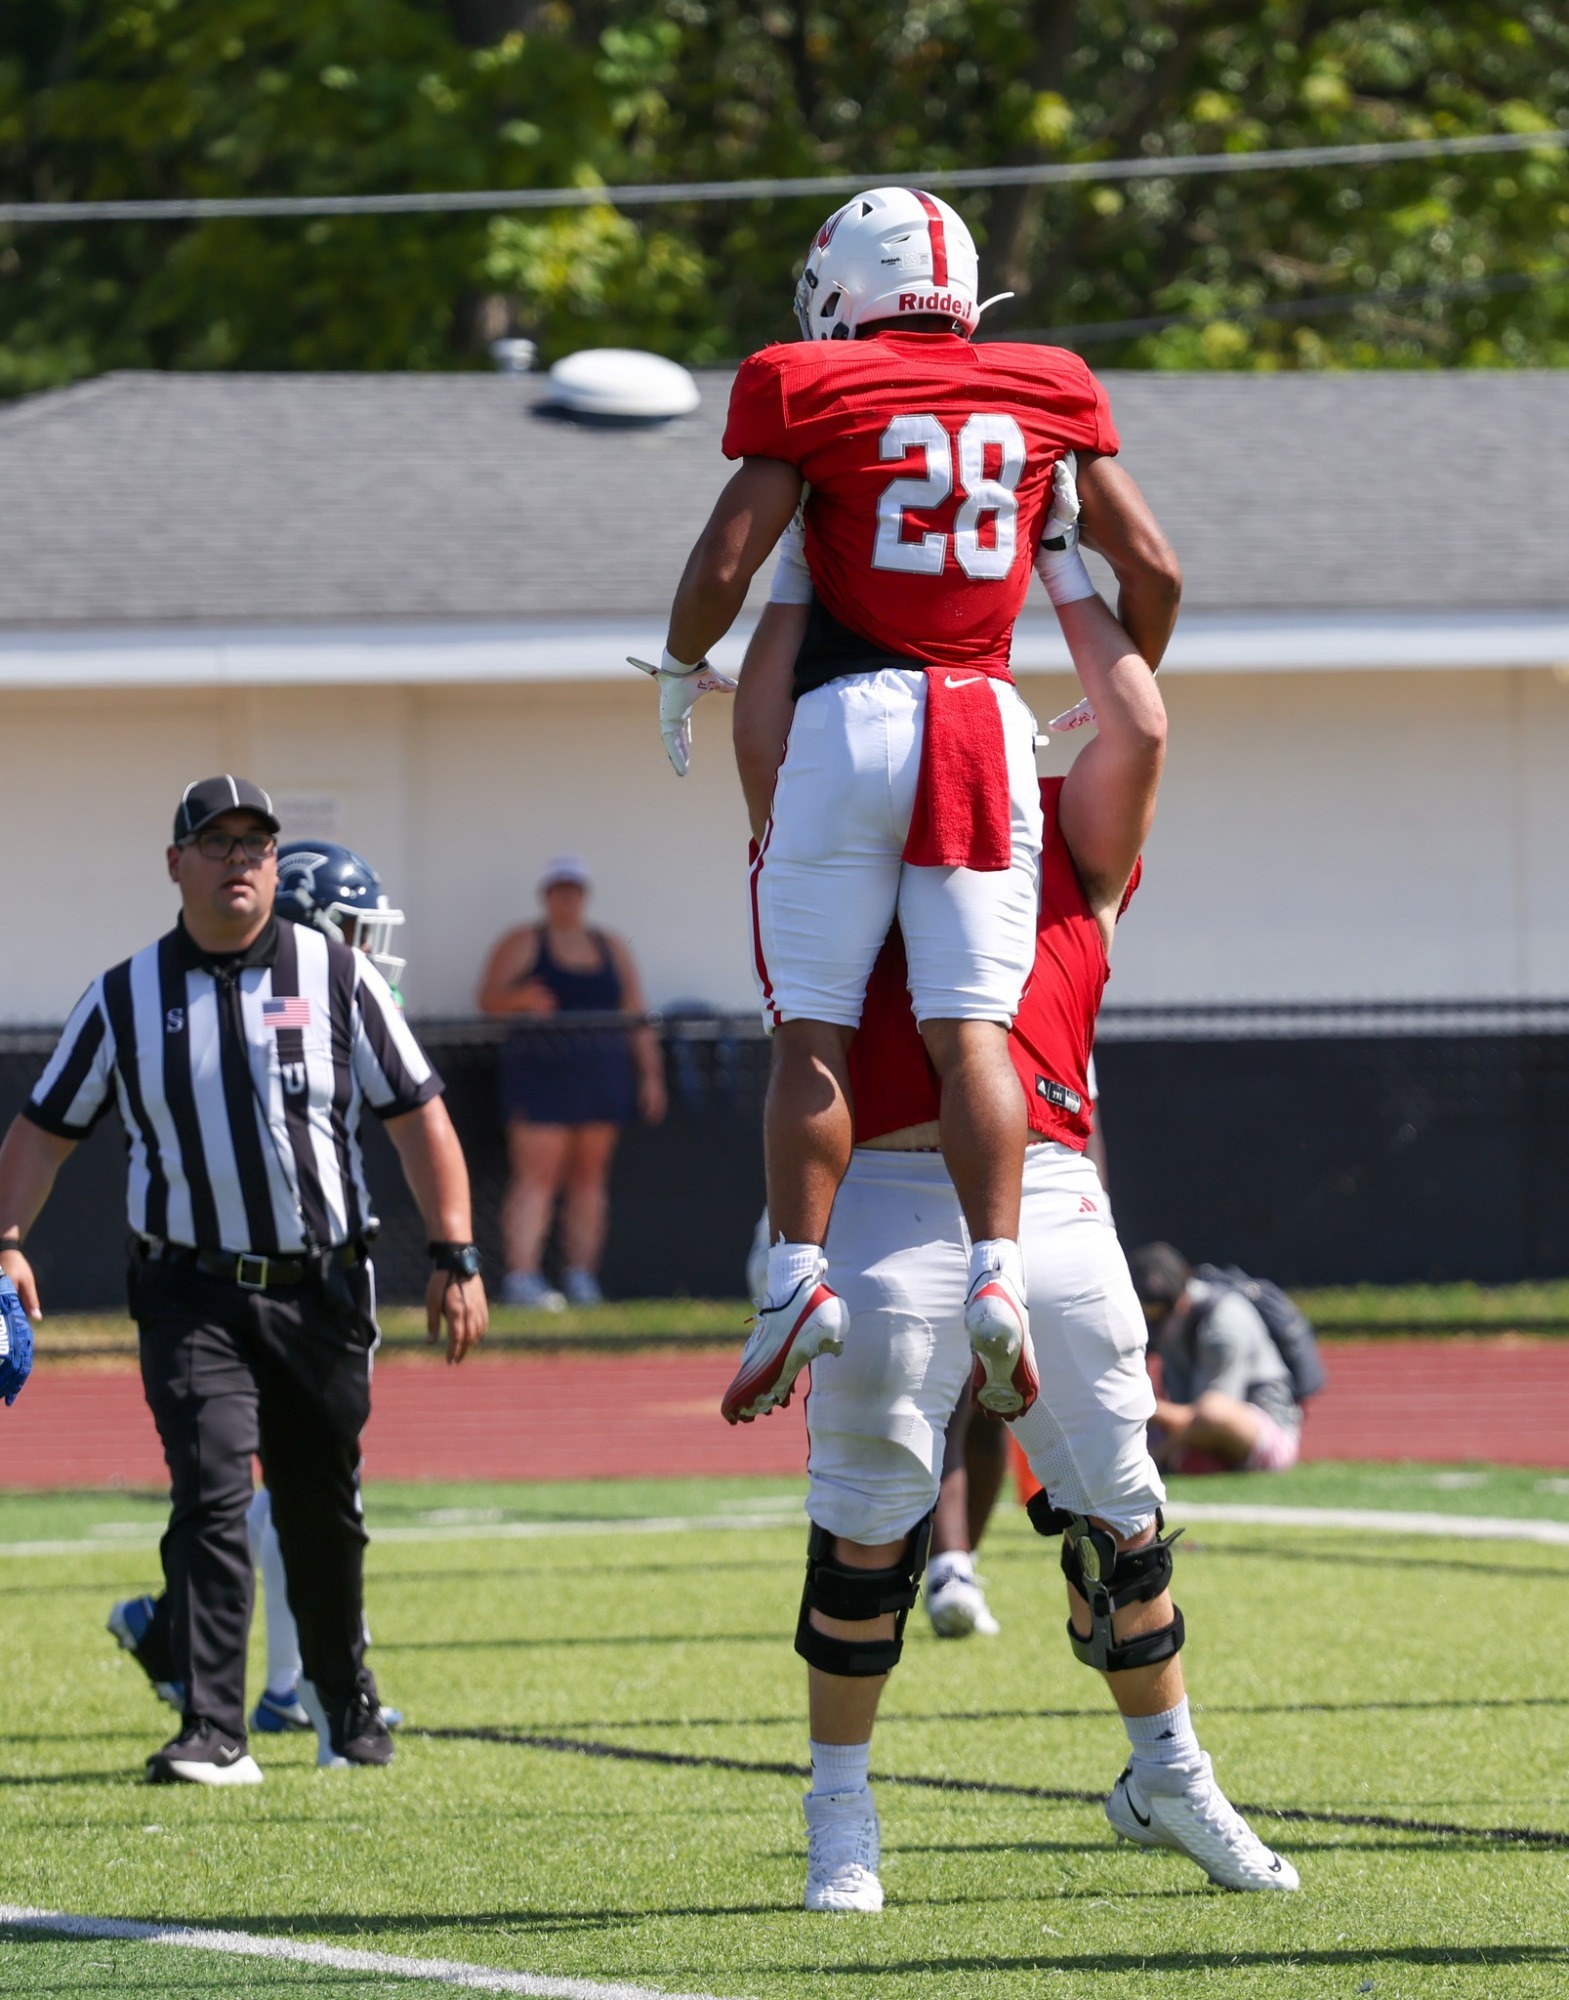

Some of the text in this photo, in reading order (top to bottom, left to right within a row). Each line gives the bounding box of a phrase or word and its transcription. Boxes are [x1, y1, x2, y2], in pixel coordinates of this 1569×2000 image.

[871, 413, 1027, 579] 28
[166, 1008, 184, 1033] S
[282, 1062, 305, 1094] U
